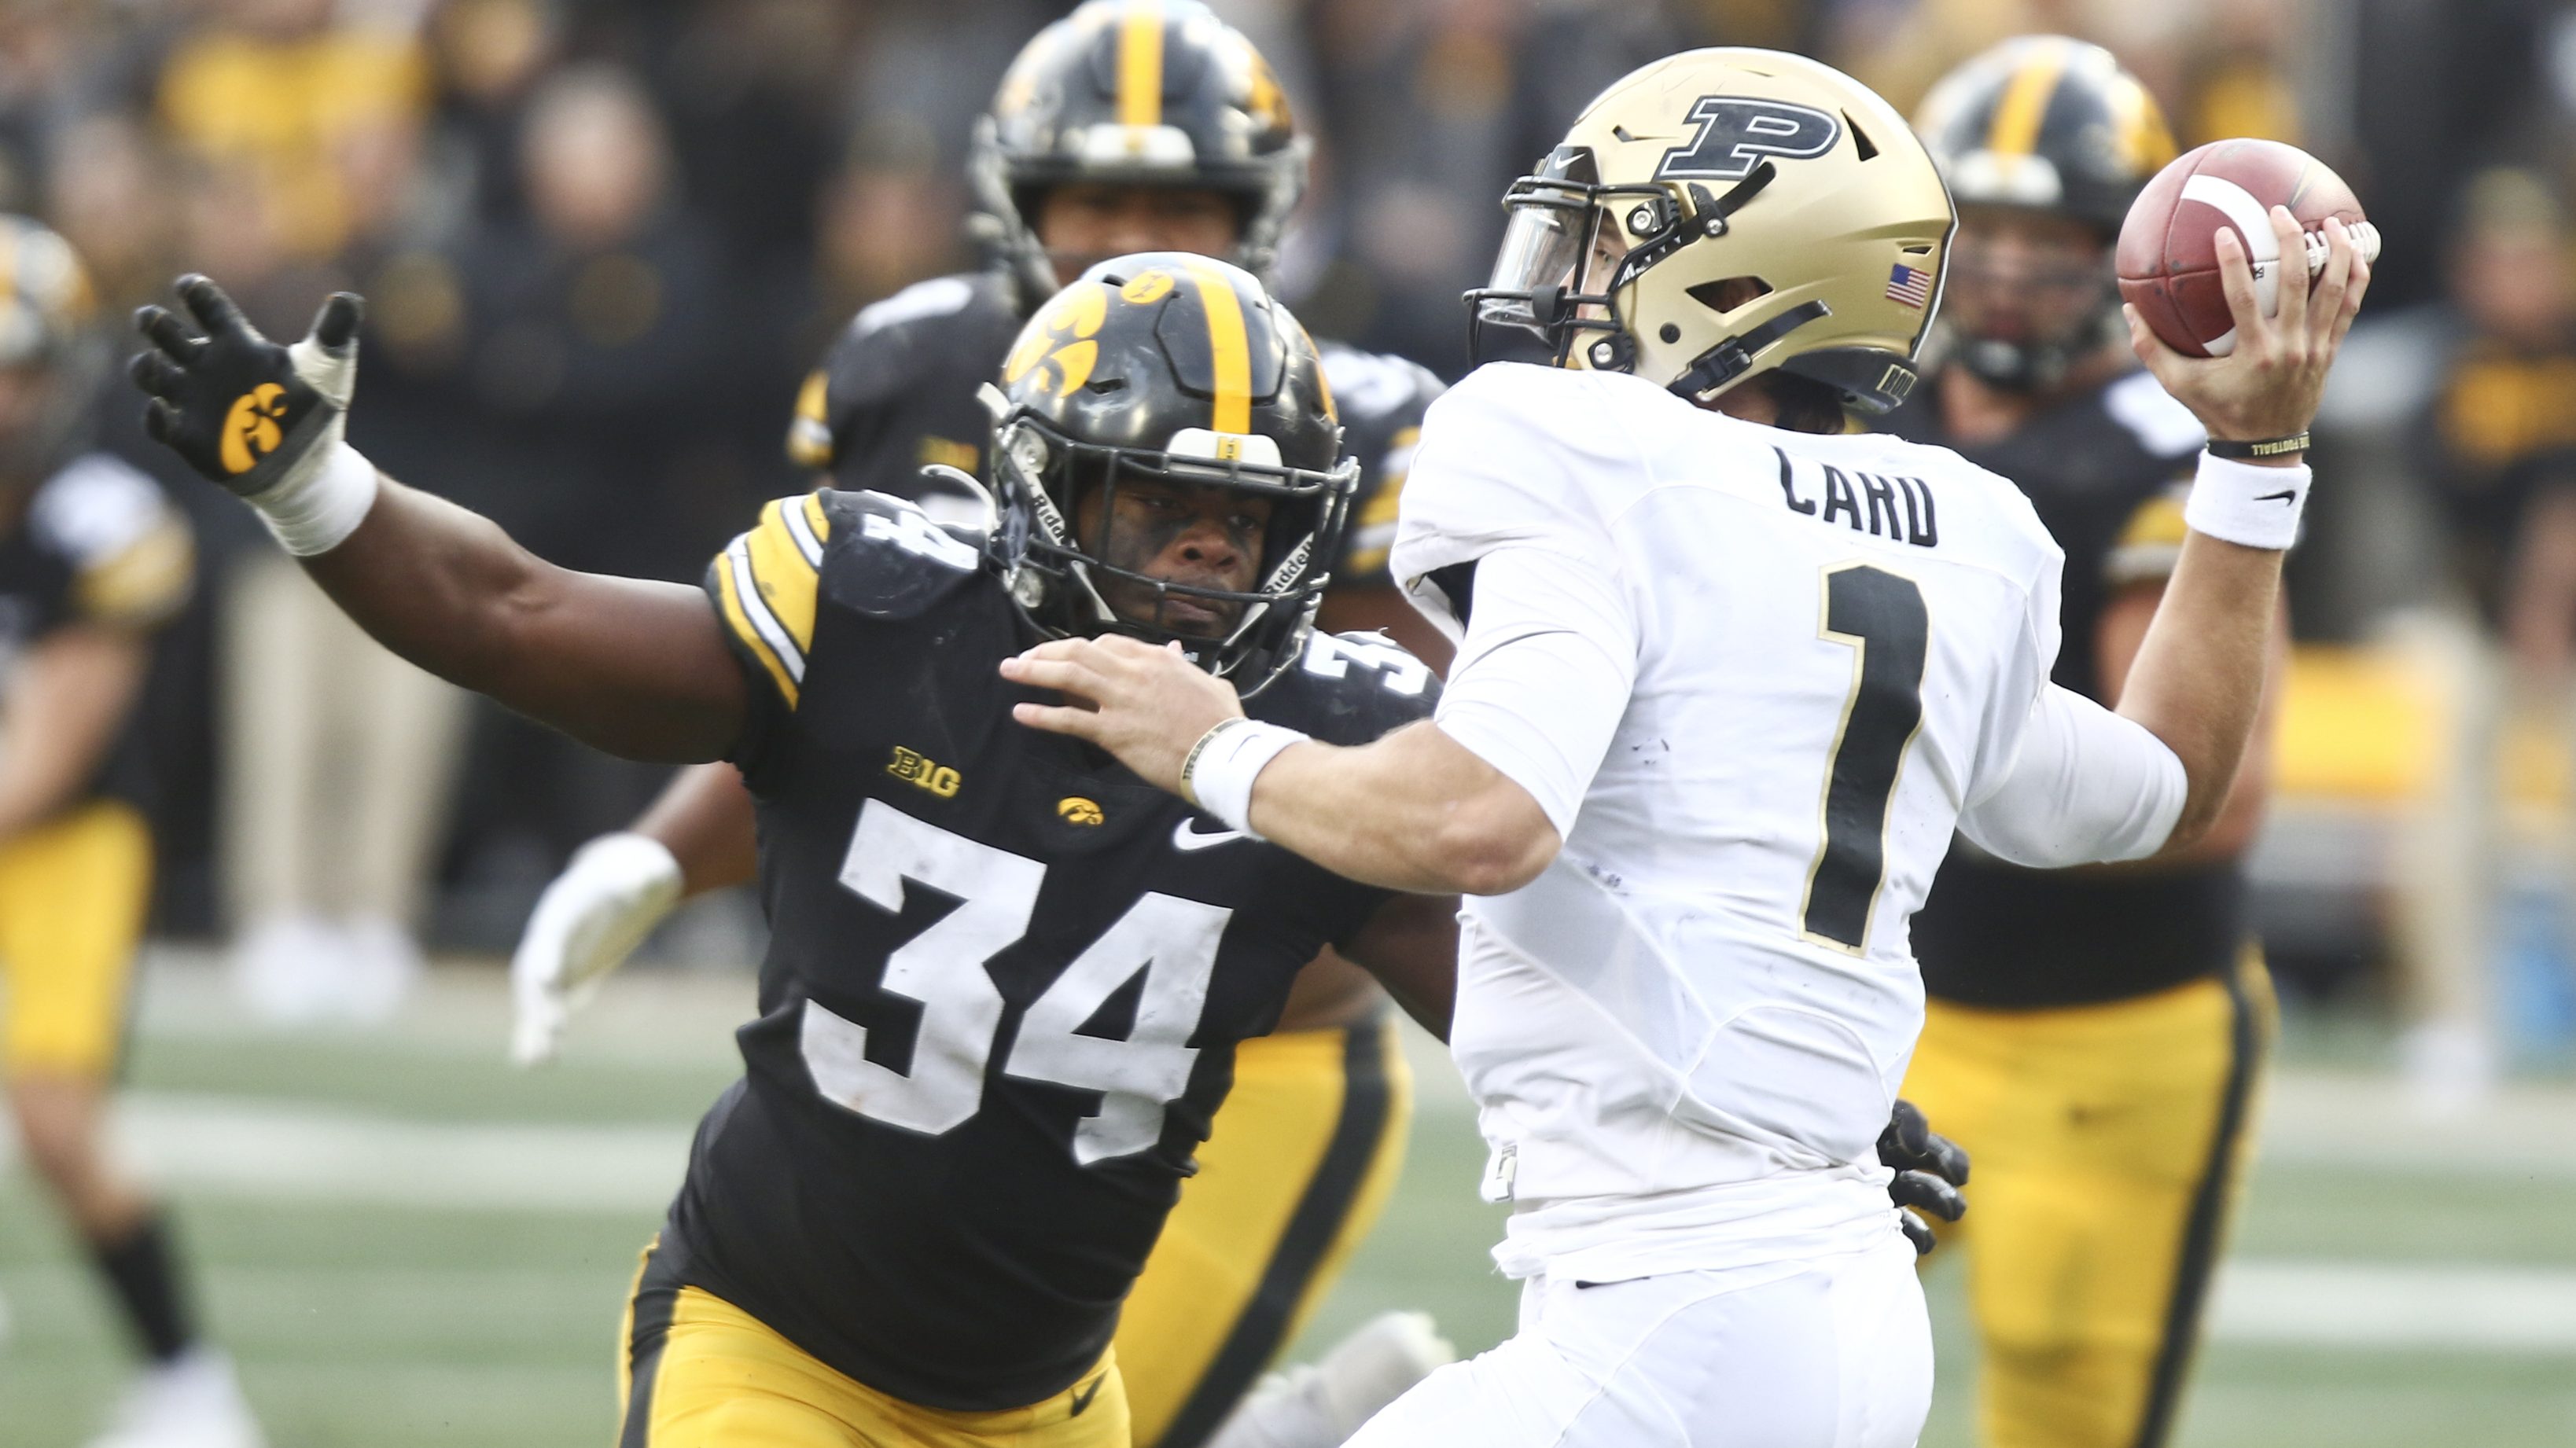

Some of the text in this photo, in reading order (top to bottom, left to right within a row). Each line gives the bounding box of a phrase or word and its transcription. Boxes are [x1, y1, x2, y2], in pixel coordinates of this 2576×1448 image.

[1650, 95, 1843, 184] P
[1798, 555, 1933, 959] 1
[800, 796, 1234, 1168] 34
